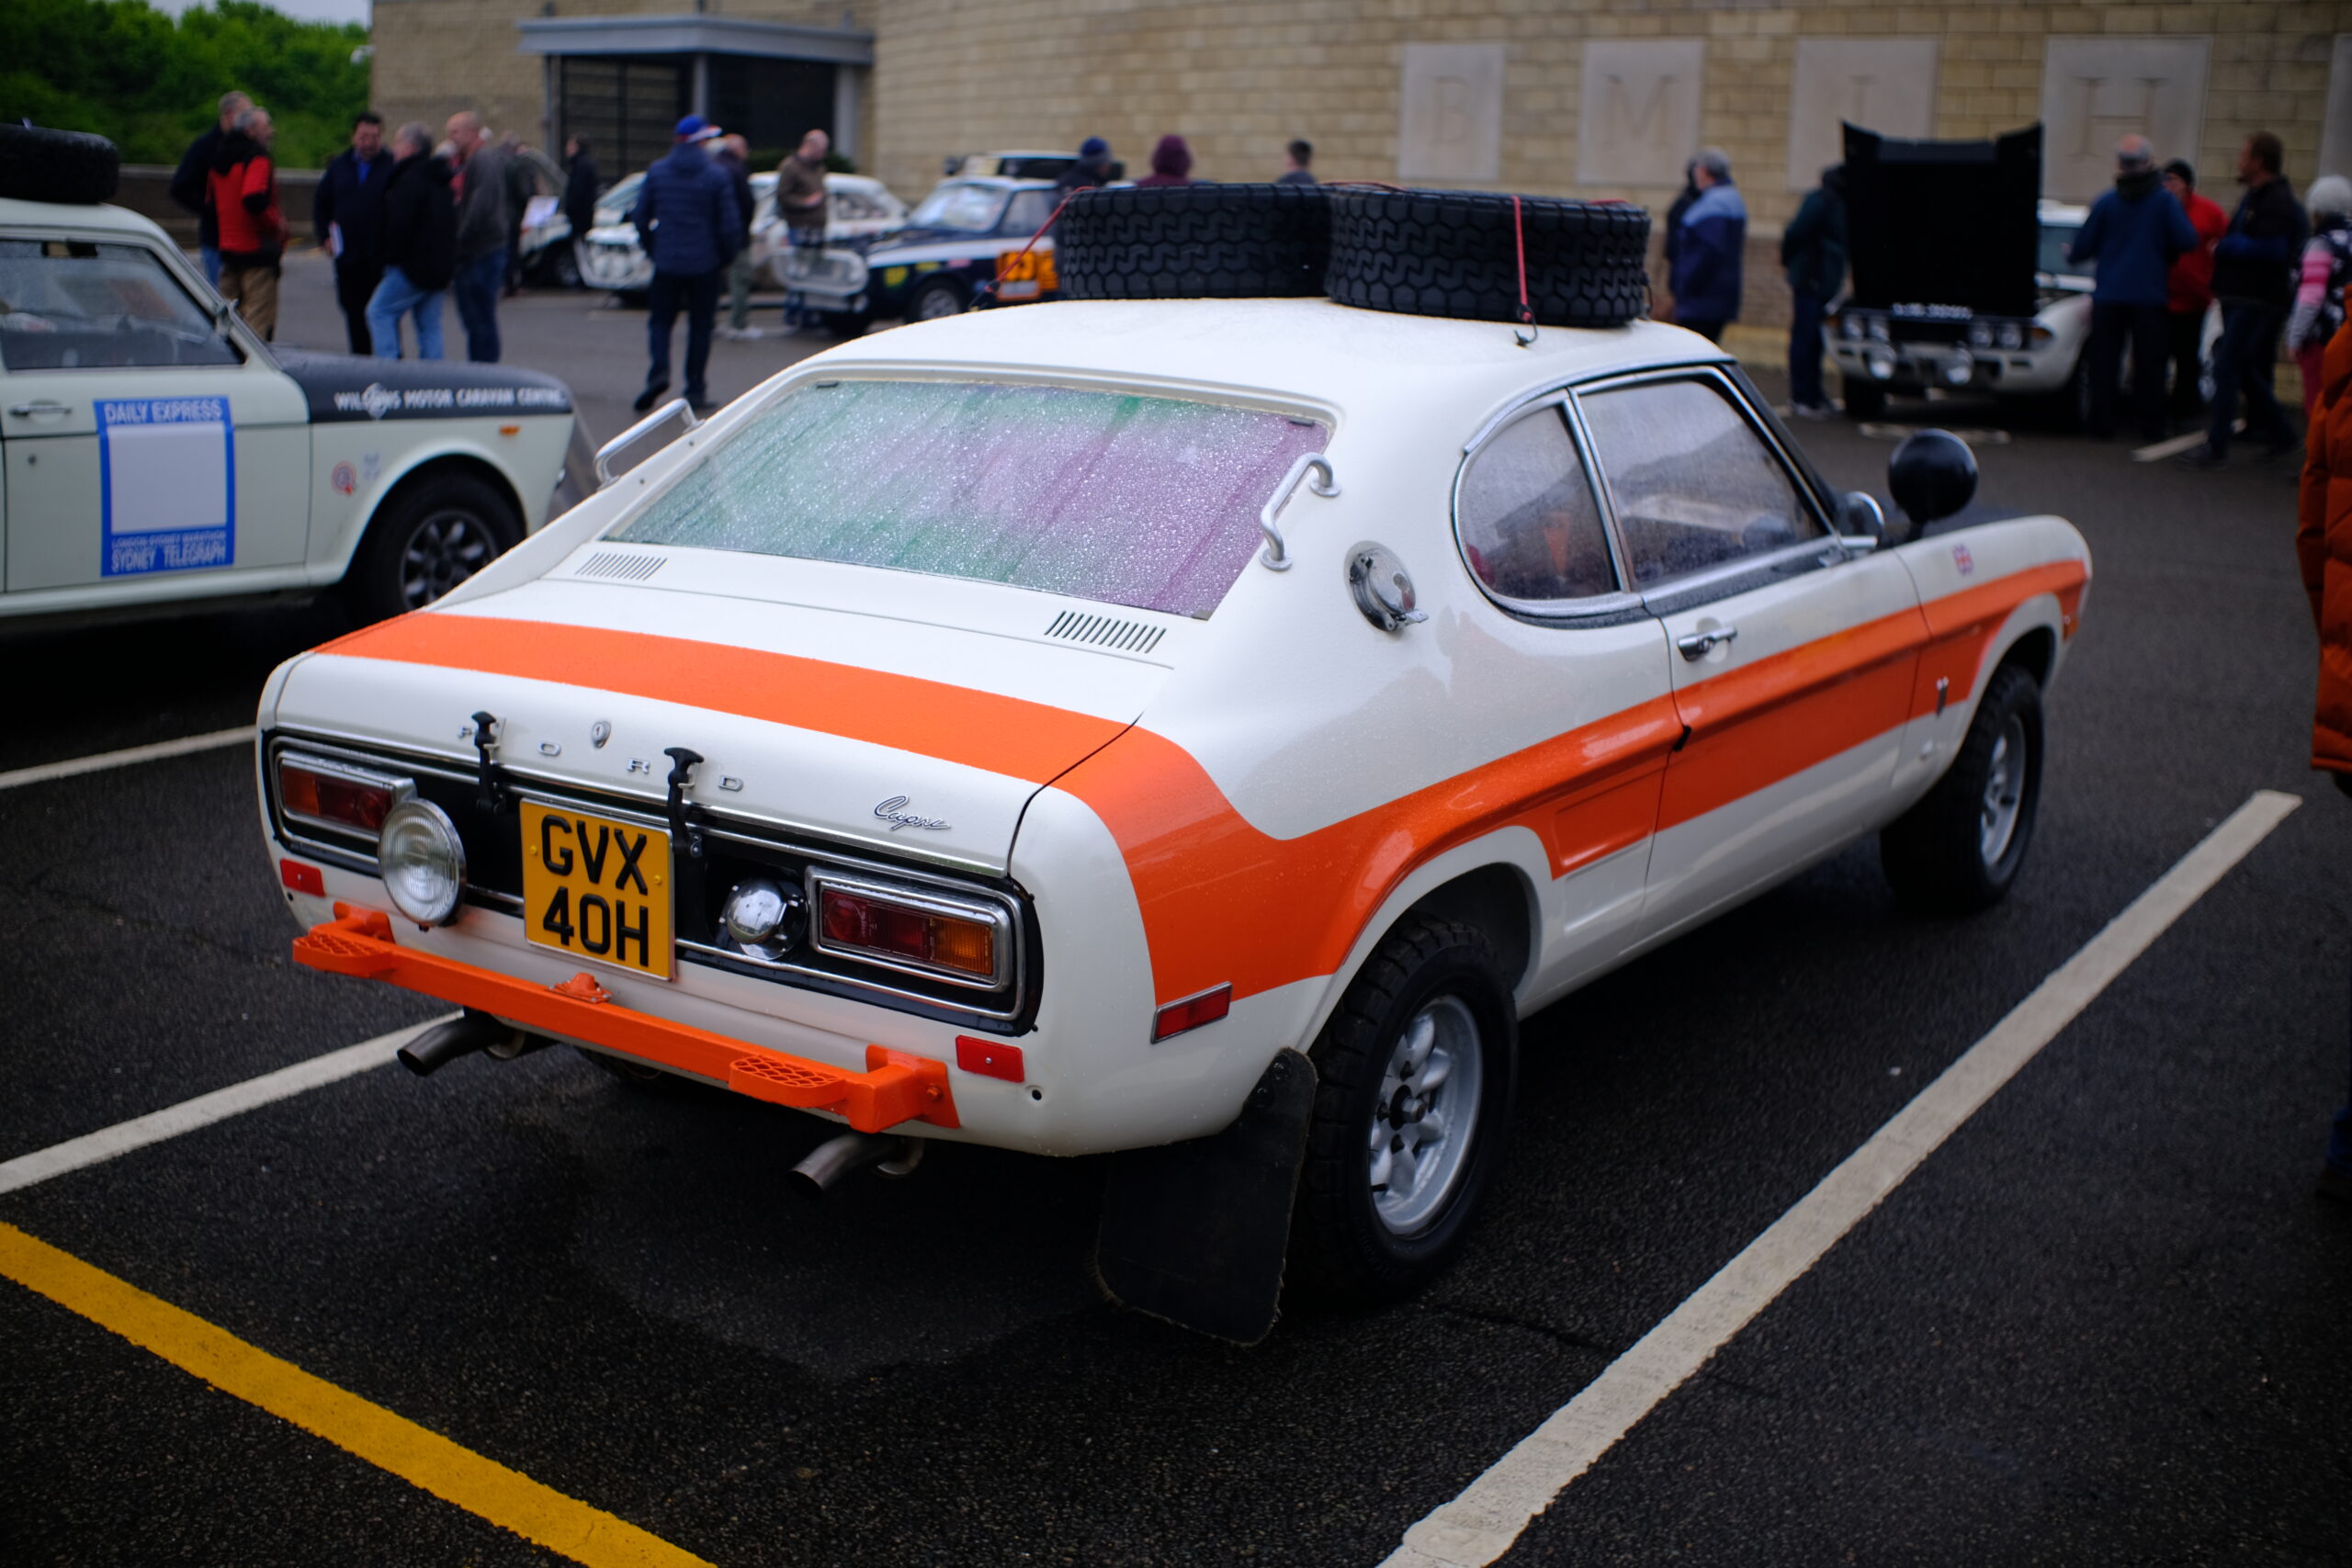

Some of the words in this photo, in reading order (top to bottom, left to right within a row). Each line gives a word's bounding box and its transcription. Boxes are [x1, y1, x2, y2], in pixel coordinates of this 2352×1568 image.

[104, 402, 148, 423] DAILY
[151, 399, 223, 423] EXPRESS
[403, 389, 454, 409] MOTOR
[456, 389, 514, 407] CARAVAN
[111, 548, 156, 573] SYDNEY
[164, 540, 227, 568] TELEGRAPH
[874, 795, 952, 831] Capri
[541, 814, 649, 896] GVX
[543, 886, 649, 967] 40H
